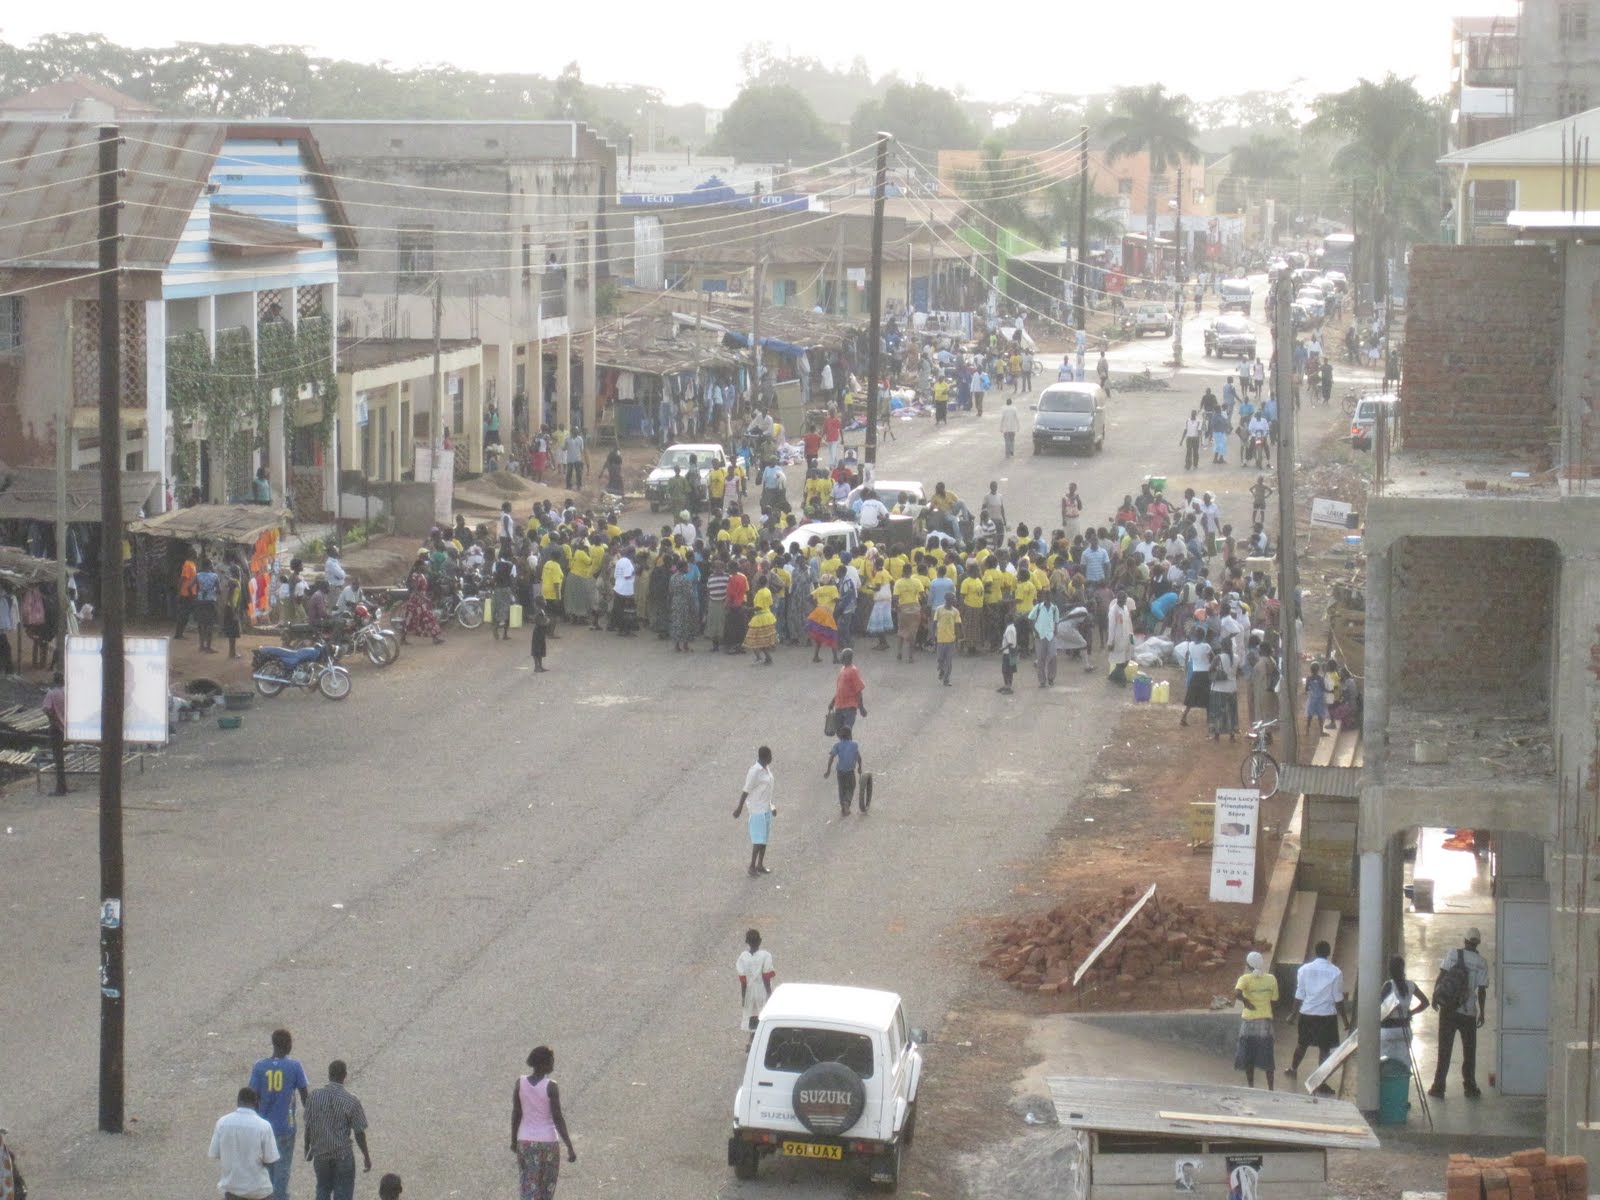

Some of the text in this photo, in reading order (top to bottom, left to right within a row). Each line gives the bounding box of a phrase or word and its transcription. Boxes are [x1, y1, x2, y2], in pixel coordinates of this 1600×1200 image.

[641, 194, 674, 203] TECNO
[749, 195, 782, 203] TCNO
[265, 1070, 283, 1091] 10
[800, 1090, 852, 1105] SUZUKI
[760, 1111, 797, 1121] SUZUK
[786, 1143, 838, 1158] 961 UAX
